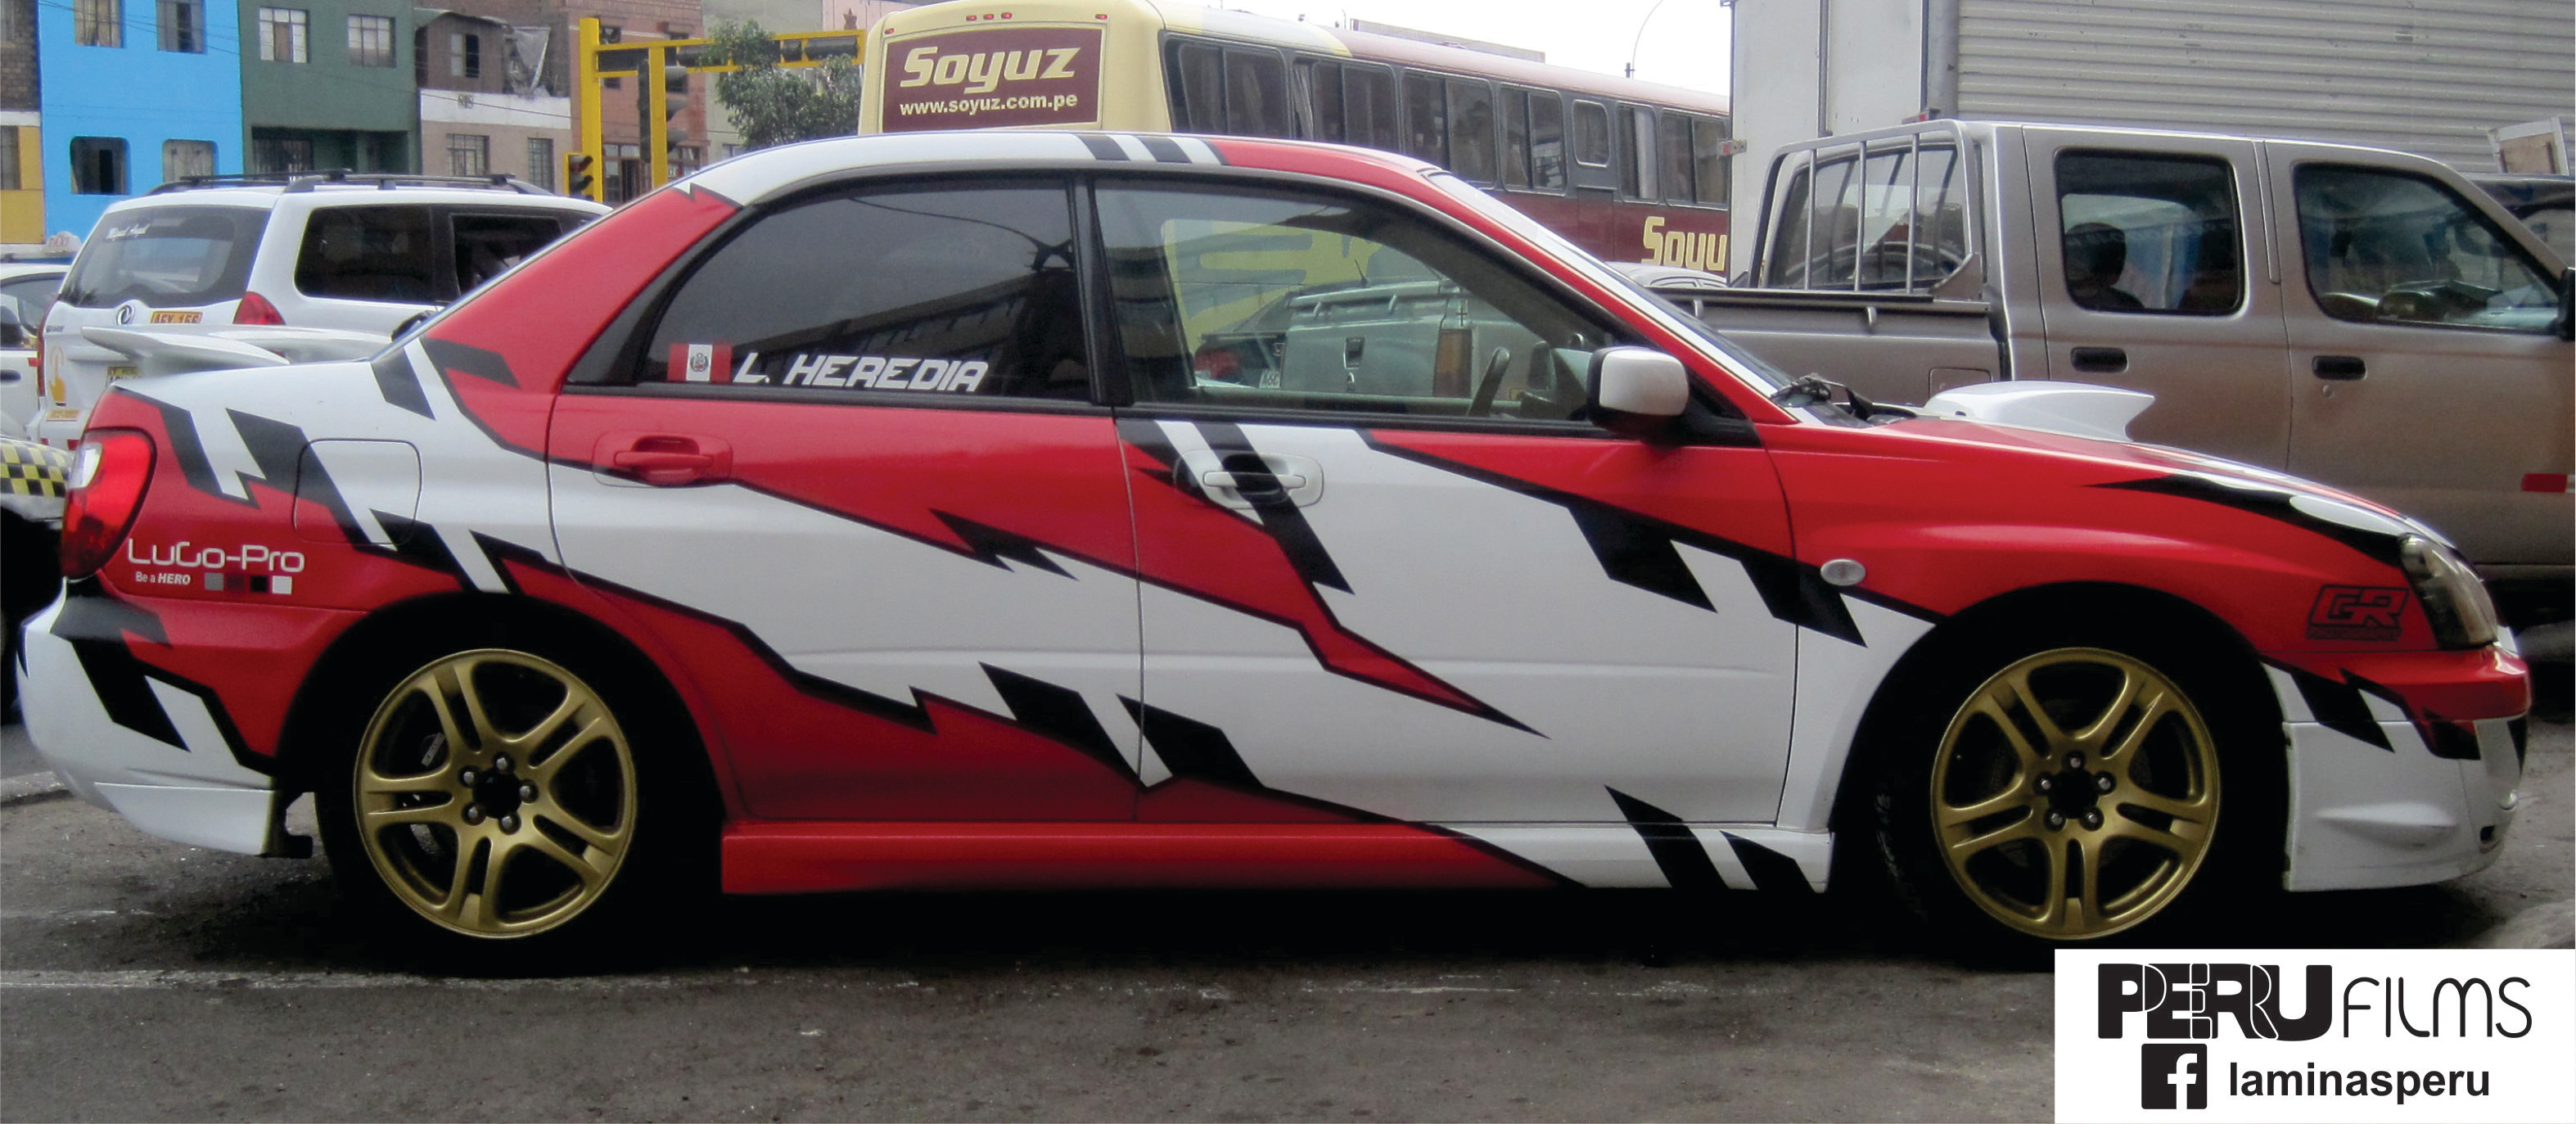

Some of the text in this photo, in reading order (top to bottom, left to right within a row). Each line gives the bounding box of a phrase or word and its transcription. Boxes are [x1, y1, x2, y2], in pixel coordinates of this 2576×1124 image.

[900, 47, 1080, 94] Soyuz
[900, 94, 1078, 115] www.soyuz.com.pe
[1640, 216, 1728, 272] Soyu
[733, 351, 989, 392] L. HEREDIA
[128, 538, 305, 572] LuGo-Pro
[135, 571, 192, 585] Be a HERO
[2308, 584, 2410, 628] GR
